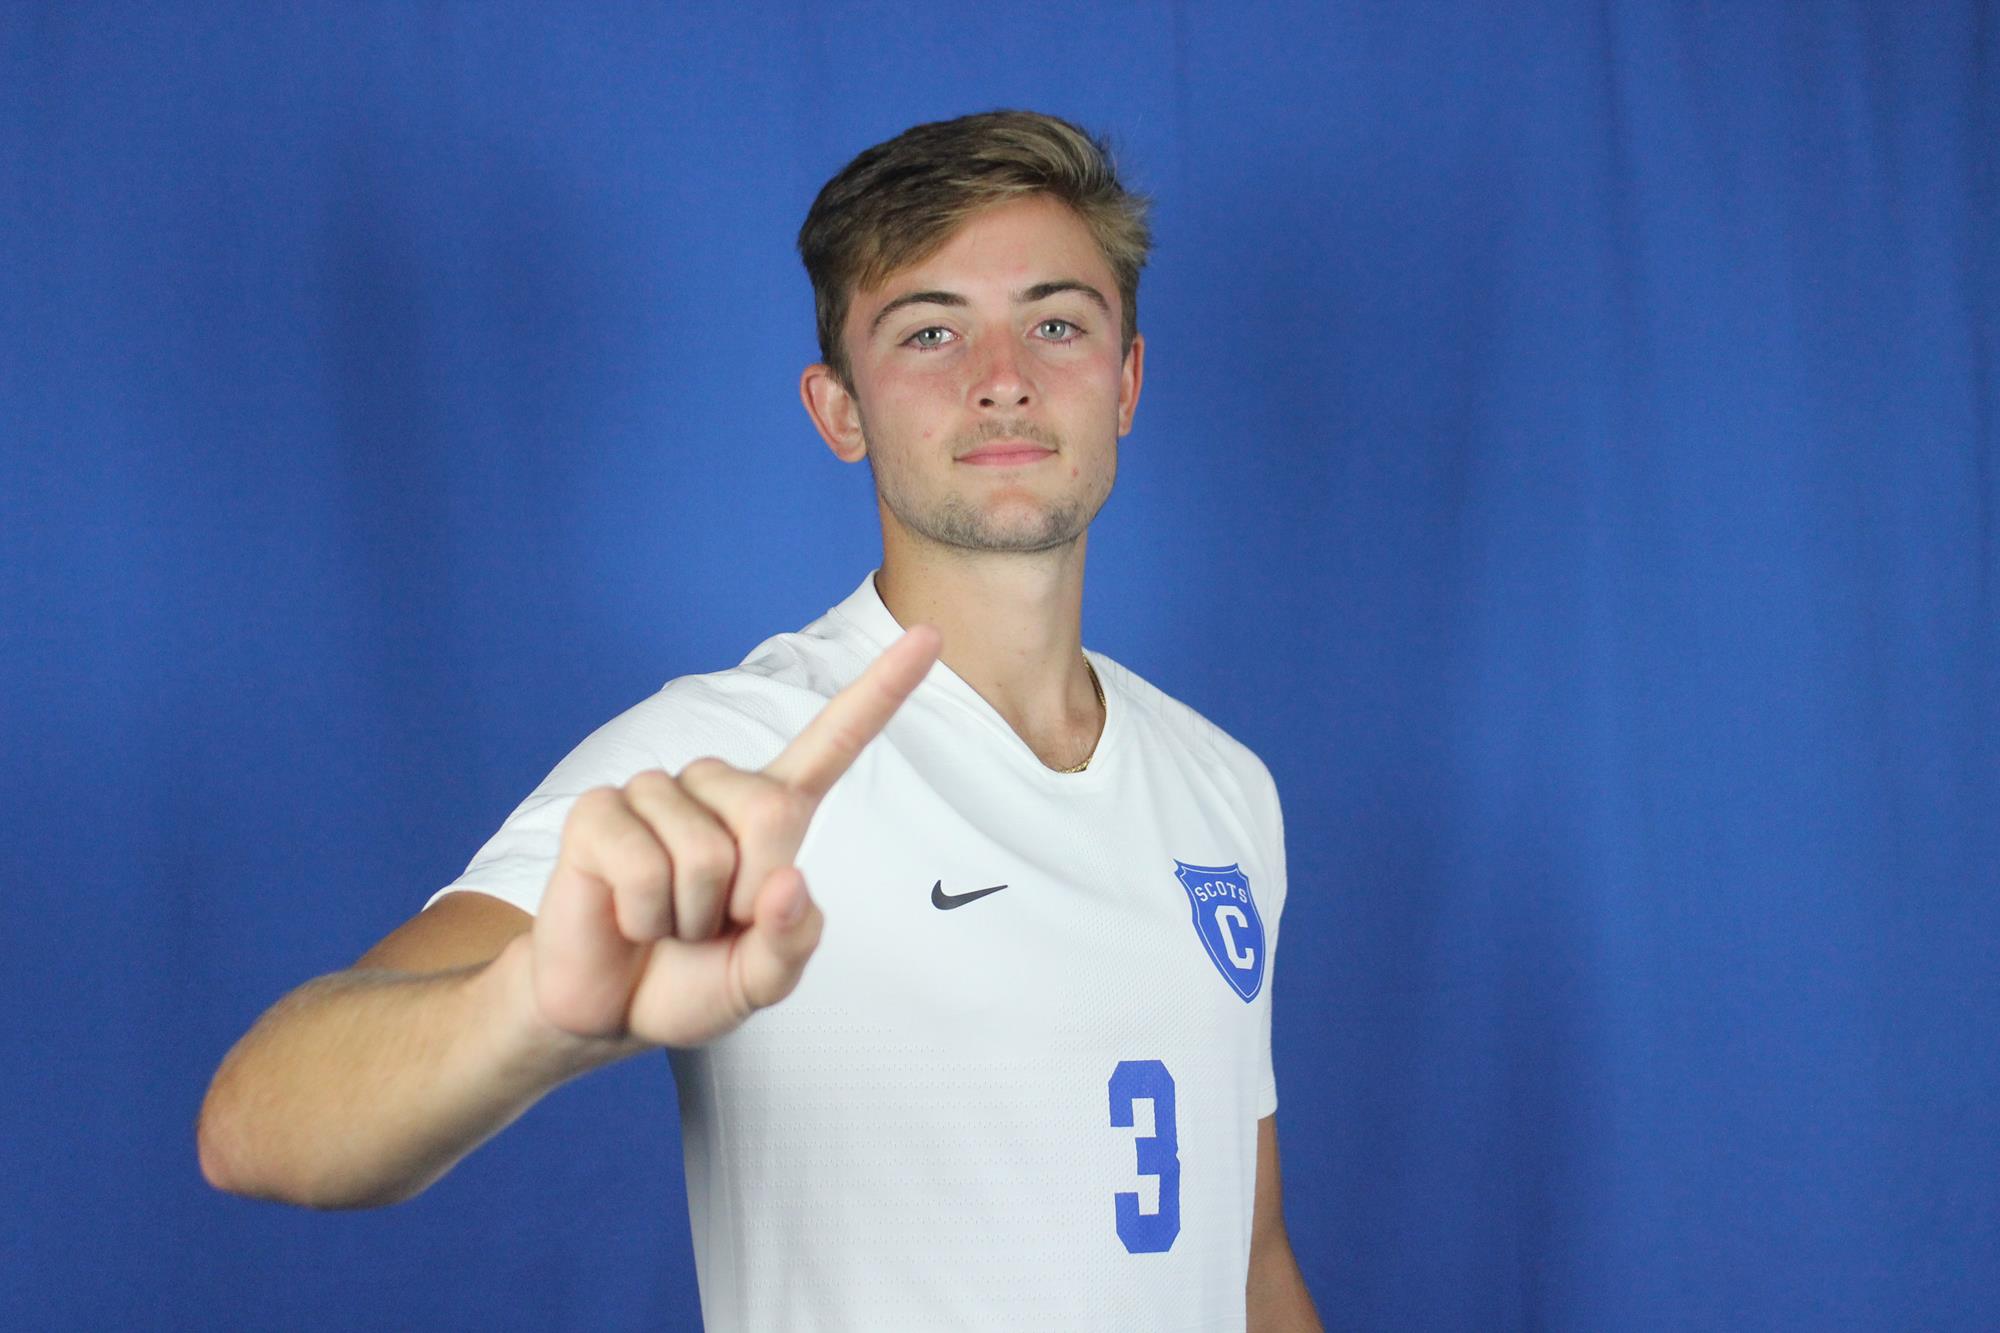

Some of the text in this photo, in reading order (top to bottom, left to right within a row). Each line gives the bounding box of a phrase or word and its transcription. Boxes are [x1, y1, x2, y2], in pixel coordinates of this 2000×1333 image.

[1194, 880, 1248, 904] SCOTS
[1214, 905, 1255, 970] C
[1108, 1059, 1181, 1254] 3
